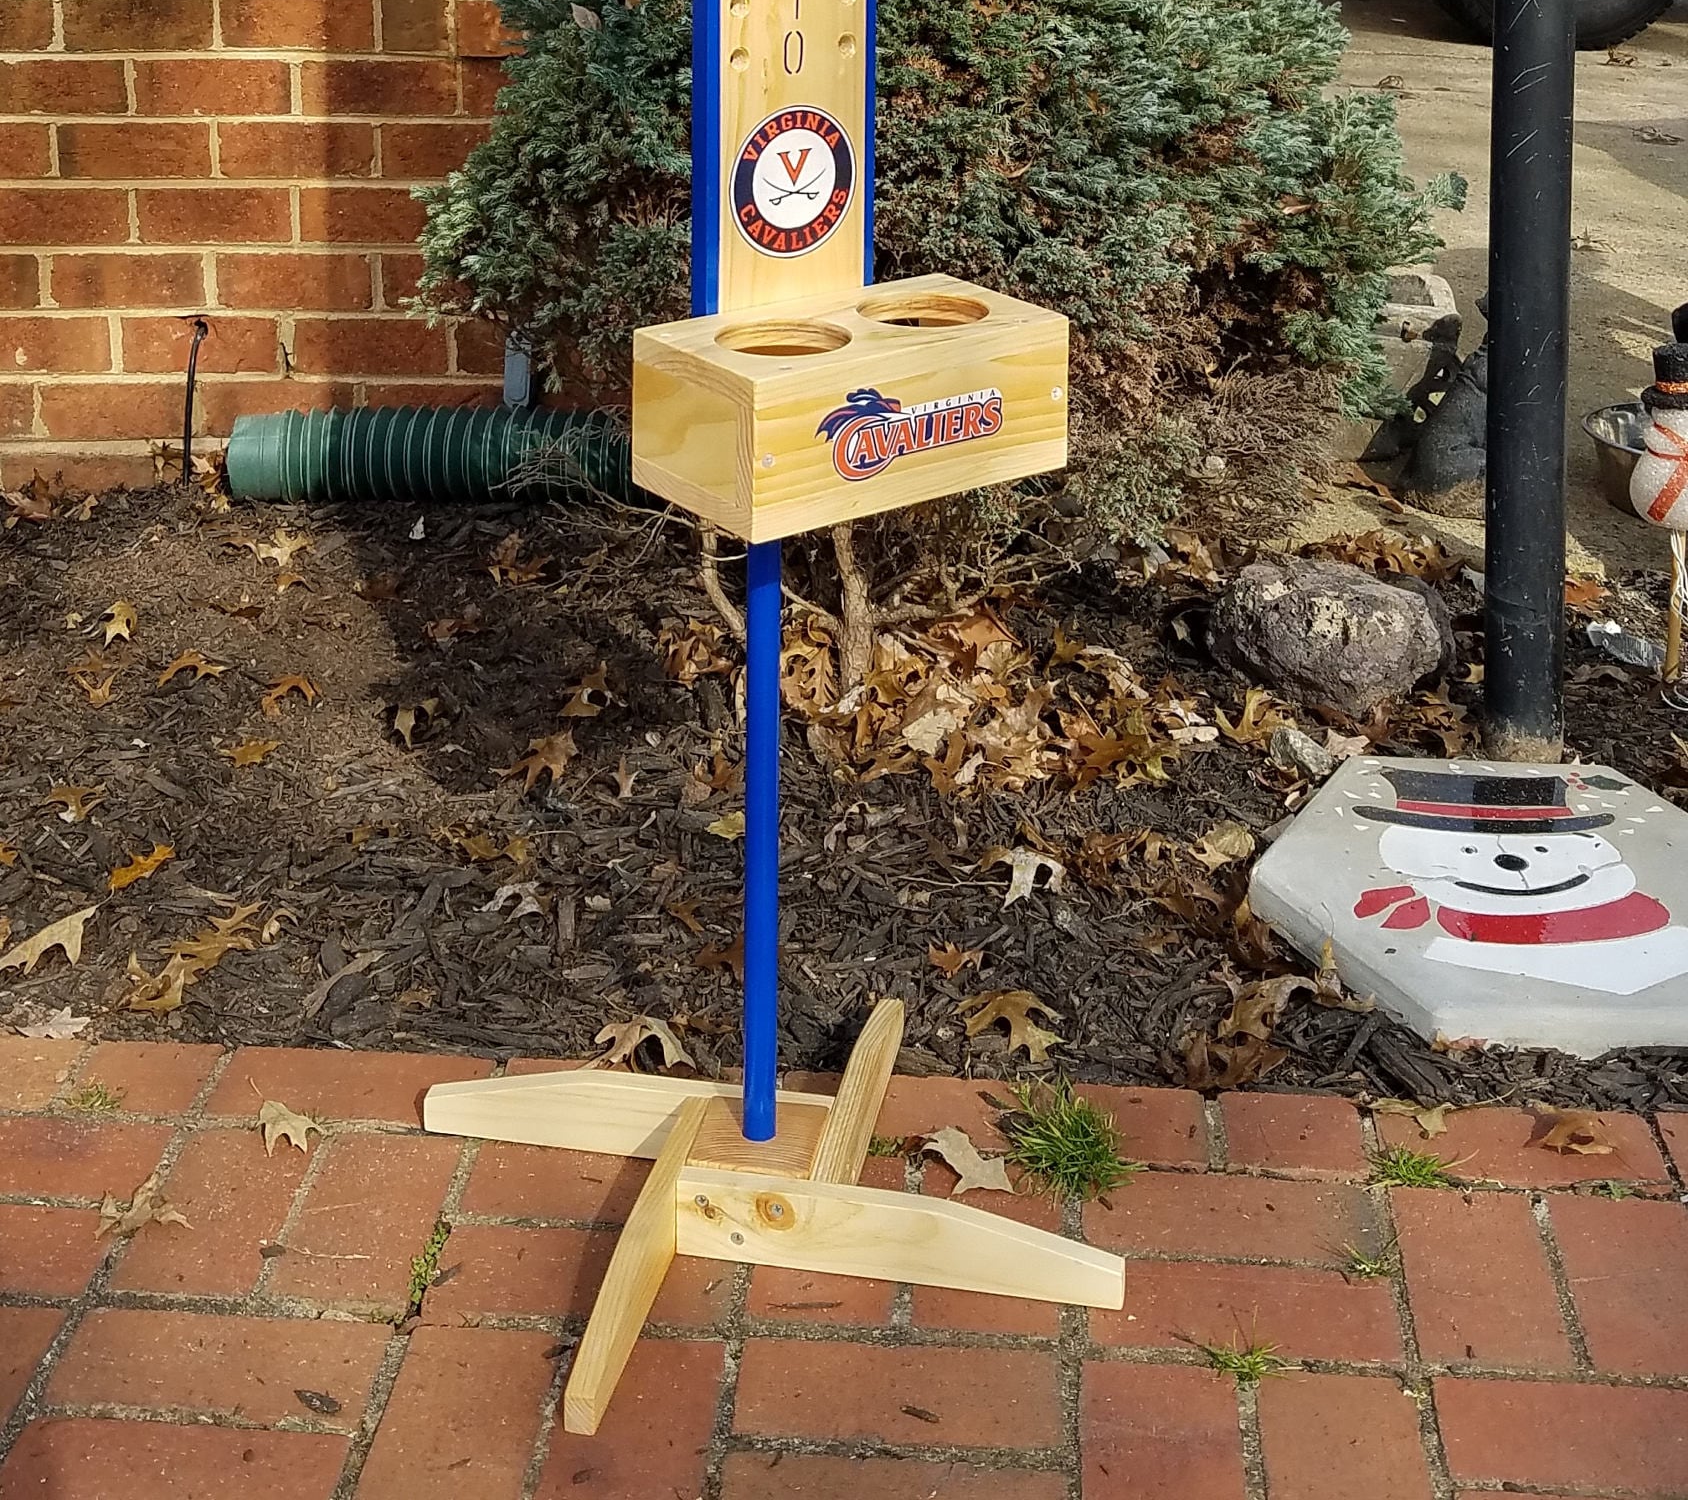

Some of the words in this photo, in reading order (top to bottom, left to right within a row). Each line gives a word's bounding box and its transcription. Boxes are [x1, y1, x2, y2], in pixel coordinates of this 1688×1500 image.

[783, 30, 804, 74] 0
[742, 111, 841, 161] VIRGINIA
[776, 148, 813, 187] V
[739, 188, 848, 251] CAVALIERS
[911, 389, 996, 414] VIRGINIA
[834, 398, 1002, 480] CAVALIERS
